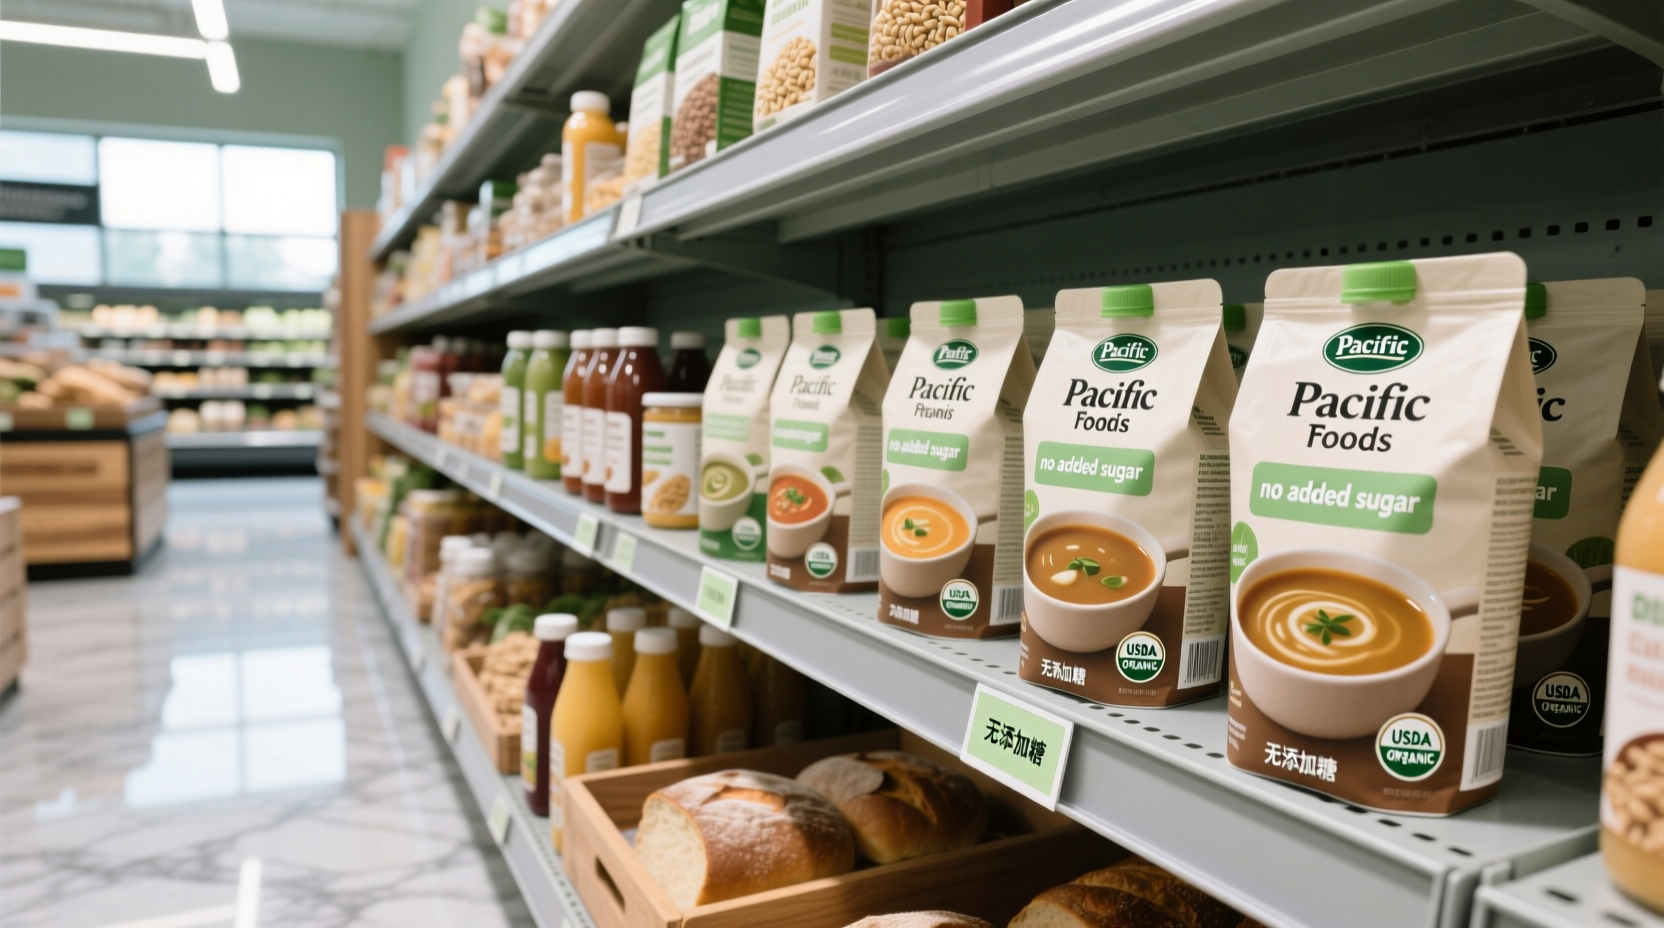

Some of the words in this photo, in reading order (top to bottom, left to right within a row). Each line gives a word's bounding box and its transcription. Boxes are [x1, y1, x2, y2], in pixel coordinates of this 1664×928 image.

[1101, 341, 1149, 359] Pacific
[1335, 335, 1409, 357] Pacific
[909, 376, 975, 402] Pacific
[1062, 378, 1158, 410] Pacific
[1286, 381, 1431, 422] Pacific
[1074, 411, 1130, 433] Foods
[1306, 424, 1392, 452] Foods
[930, 445, 961, 461] sugar
[1040, 457, 1055, 470] no
[1057, 456, 1098, 476] added
[1100, 464, 1144, 483] sugar
[1259, 482, 1283, 499] no
[1287, 480, 1352, 508] added
[1354, 491, 1421, 518] sugar
[1127, 643, 1157, 657] USDA
[1545, 684, 1581, 700] USDA
[984, 717, 1047, 767] 无添加糖
[1391, 729, 1431, 747] USDA
[1264, 741, 1338, 783] 无添加糖
